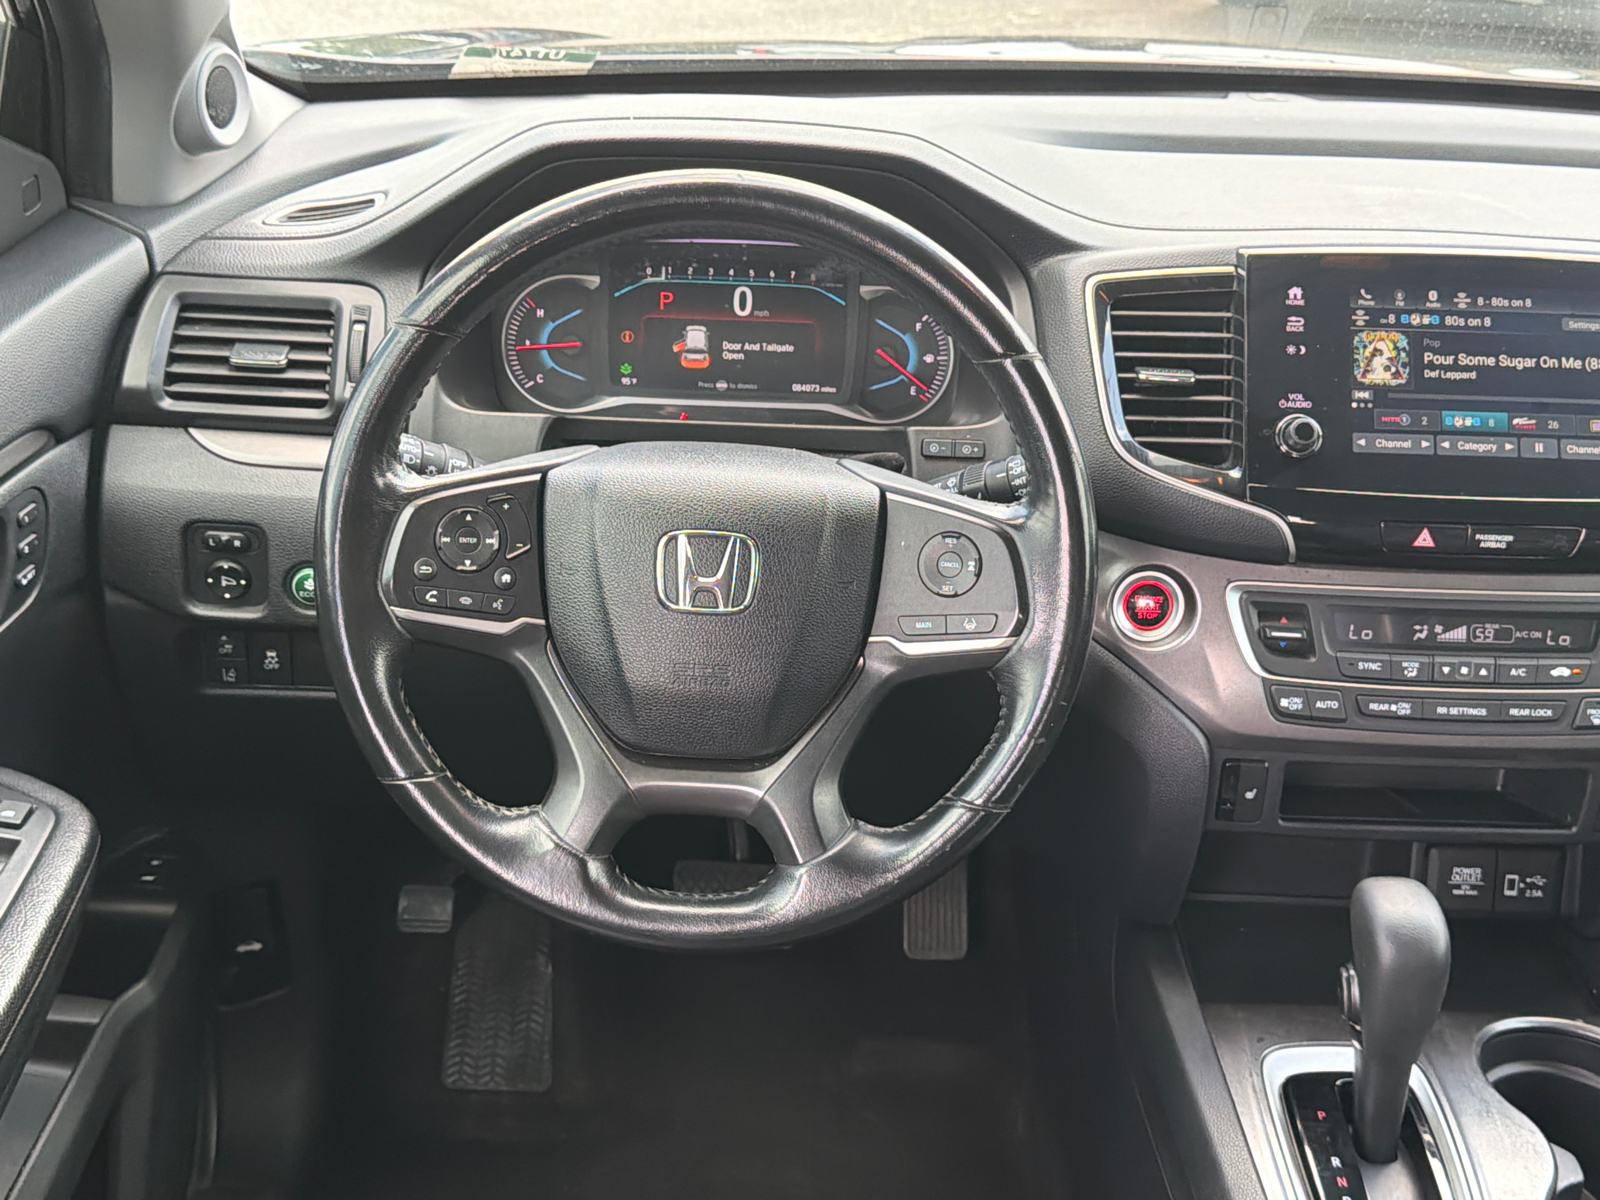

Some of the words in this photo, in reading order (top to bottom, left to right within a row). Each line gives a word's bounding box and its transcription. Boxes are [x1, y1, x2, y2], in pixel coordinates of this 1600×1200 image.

[646, 267, 652, 275] 0
[668, 266, 672, 274] 1
[688, 267, 693, 275] 2
[708, 268, 714, 276] 3
[728, 268, 734, 276] 4
[749, 269, 754, 277] 5
[770, 270, 775, 278] 6
[790, 270, 796, 279] 7
[660, 292, 674, 310] P
[733, 286, 753, 317] 0
[754, 310, 770, 318] mph
[1477, 297, 1484, 306] 8
[1491, 297, 1510, 307] 80s
[1525, 298, 1532, 308] 8
[536, 308, 544, 318] H
[1388, 314, 1396, 324] 8
[1445, 316, 1465, 326] 80s
[1467, 318, 1482, 327] on
[1484, 316, 1492, 327] 8
[916, 322, 922, 332] F
[1568, 320, 1600, 331] Settings
[722, 341, 742, 351] Door
[744, 342, 760, 351] And
[762, 343, 794, 353] Tailgate
[1423, 338, 1441, 348] Pop
[722, 351, 744, 360] Open
[1424, 352, 1455, 365] Pour
[1458, 353, 1496, 366] Some
[1499, 354, 1537, 370] Sugar
[1540, 356, 1558, 368] On
[1561, 357, 1582, 369] Me
[536, 374, 544, 384] C
[1424, 369, 1439, 379] Def
[1440, 370, 1477, 381] Leppard
[621, 377, 631, 385] 95
[792, 384, 820, 392] 084073
[910, 386, 916, 395] E
[1422, 417, 1428, 425] 2
[1489, 418, 1495, 427] 8
[1547, 420, 1559, 429] 26
[1375, 438, 1412, 448] Channel
[1457, 441, 1497, 453] Category
[1475, 534, 1514, 542] PASSENGER
[1349, 624, 1373, 640] Lo
[1476, 628, 1494, 641] 59
[1546, 629, 1570, 645] Lo
[1358, 662, 1382, 671] SYNC
[1510, 668, 1527, 676] A/C
[1316, 701, 1339, 709] AUTO
[1449, 707, 1487, 716] SETTINGS
[1509, 708, 1530, 716] REAR
[1531, 709, 1553, 717] LOCK
[1317, 1111, 1327, 1120] P
[1330, 1156, 1342, 1168] R
[1336, 1176, 1348, 1188] N
